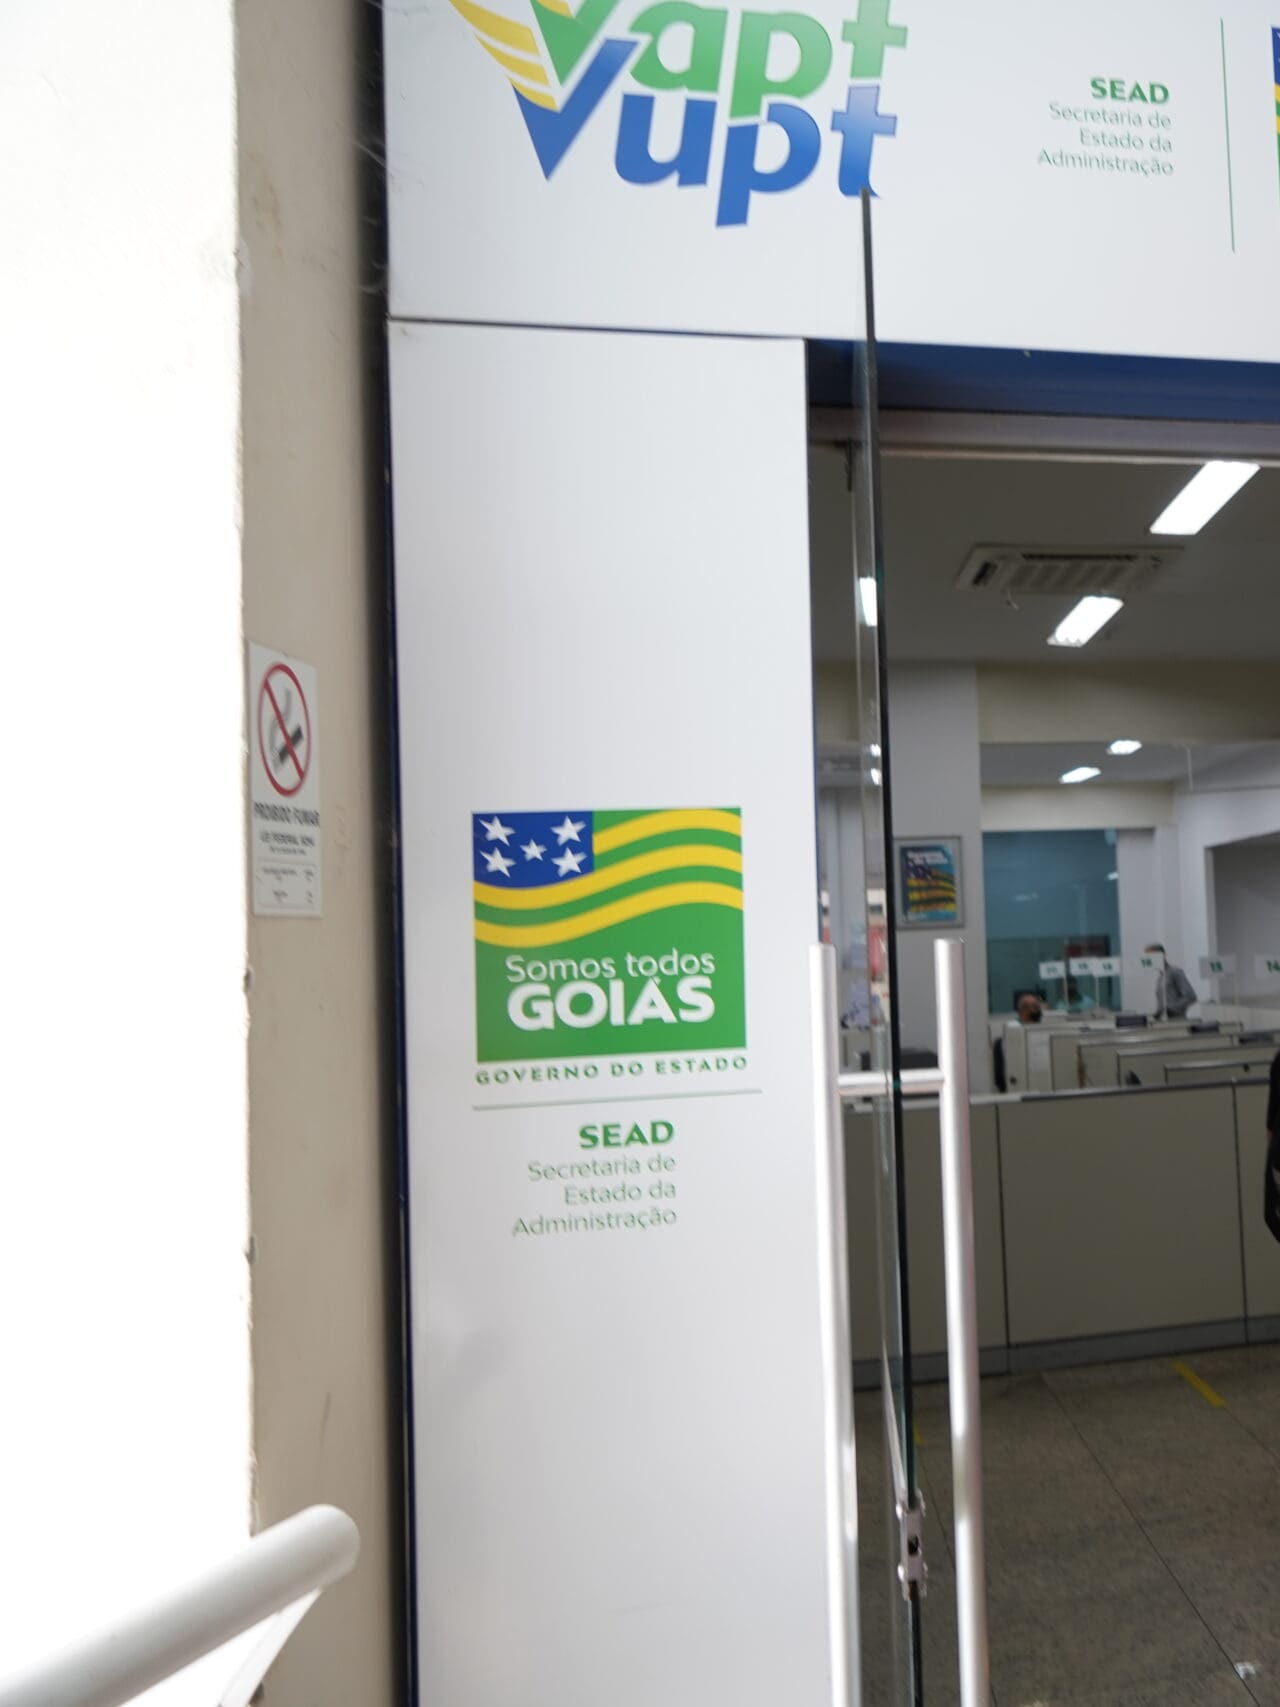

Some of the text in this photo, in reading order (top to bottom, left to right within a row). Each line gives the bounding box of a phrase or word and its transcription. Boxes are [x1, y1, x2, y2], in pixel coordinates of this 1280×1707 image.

[1090, 77, 1170, 105] SEAD
[1048, 102, 1172, 131] Secretaria de
[512, 38, 898, 228] Vupt
[1079, 128, 1173, 154] Estado da
[1037, 148, 1175, 178] Administração
[505, 947, 717, 983] Somos todos
[506, 975, 716, 1031] GOIÁS
[475, 1055, 749, 1086] GOVERNO DO ESTADO
[578, 1119, 676, 1150] SEAD
[527, 1153, 677, 1182] Secretaria de
[563, 1179, 677, 1207] Estado da
[511, 1206, 678, 1238] Administração
